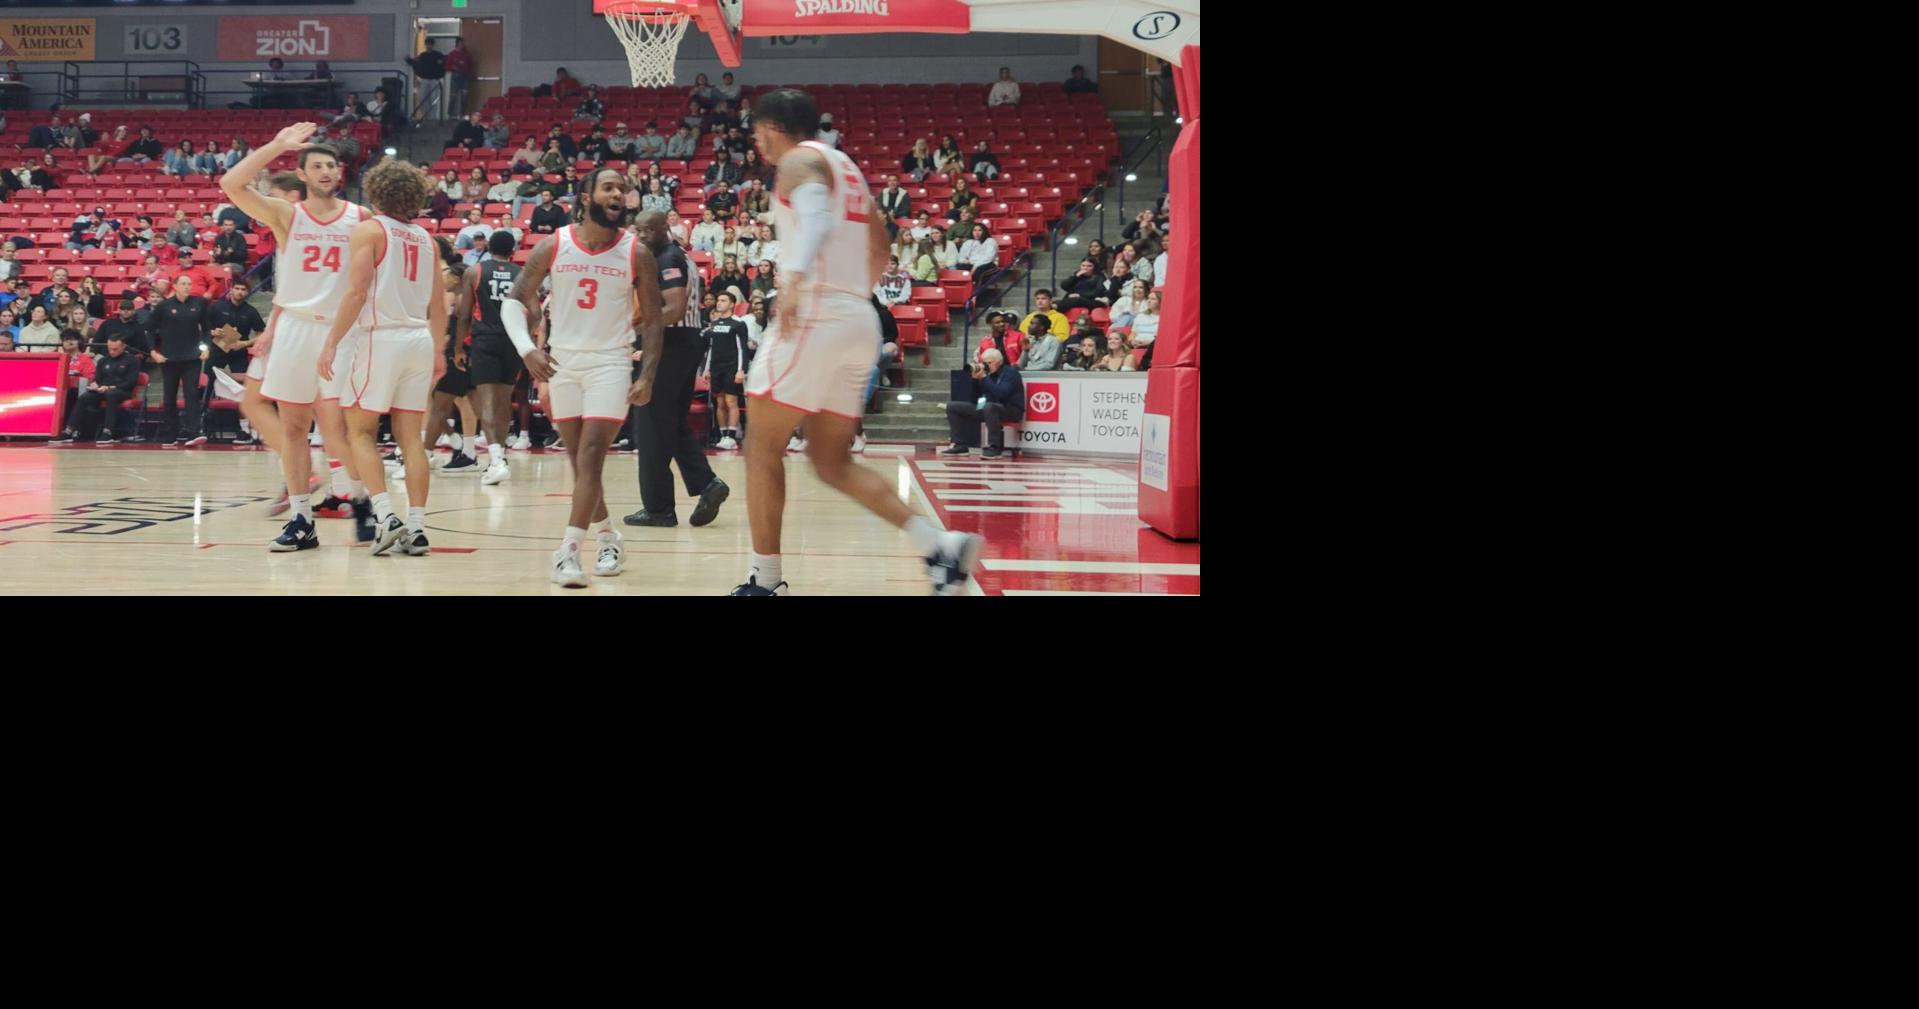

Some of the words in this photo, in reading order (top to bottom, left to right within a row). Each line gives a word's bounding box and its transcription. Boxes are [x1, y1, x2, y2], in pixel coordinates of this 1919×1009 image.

[795, 0, 889, 17] SPALDING
[12, 24, 91, 36] MOUNTAIN
[18, 37, 84, 49] AMERICA
[129, 27, 181, 50] 103
[256, 38, 315, 56] ZION
[303, 245, 341, 273] 24
[403, 241, 419, 282] 11
[556, 264, 589, 273] UTAH
[594, 265, 626, 277] TECH
[577, 278, 599, 310] 3
[1092, 409, 1128, 421] WADE
[1017, 430, 1066, 444] TOYOTA
[1092, 425, 1139, 438] TOYOTA
